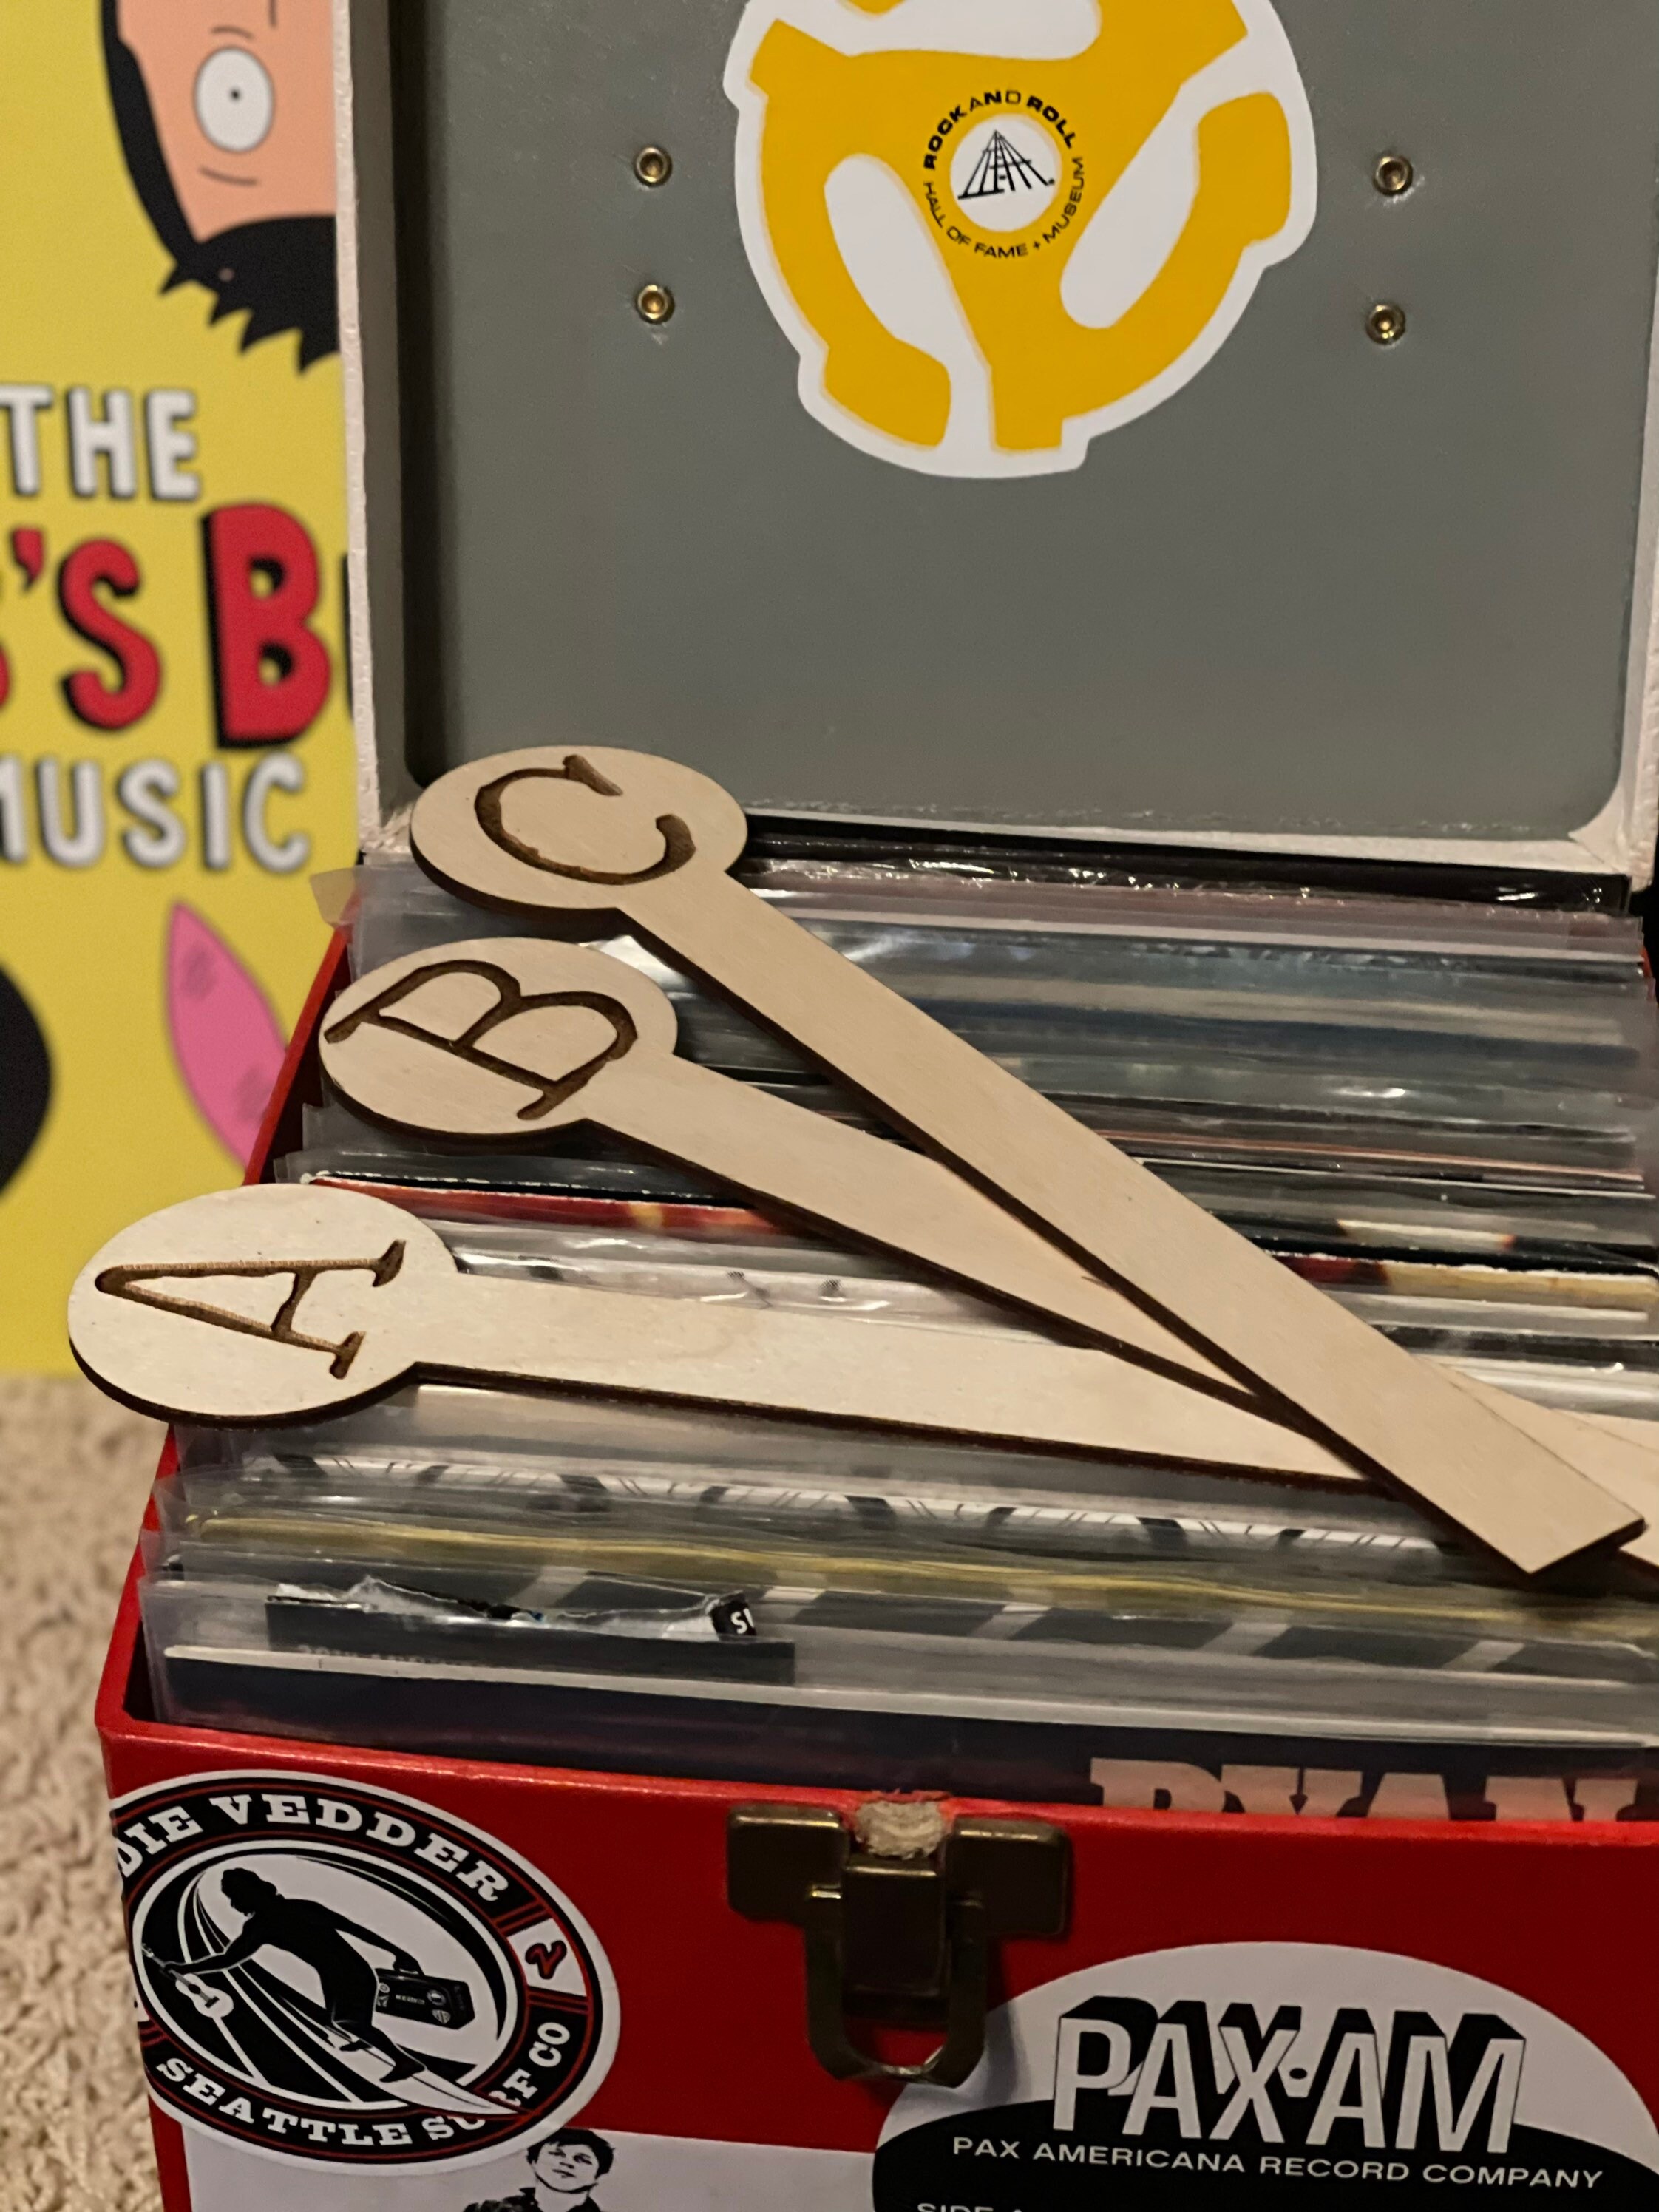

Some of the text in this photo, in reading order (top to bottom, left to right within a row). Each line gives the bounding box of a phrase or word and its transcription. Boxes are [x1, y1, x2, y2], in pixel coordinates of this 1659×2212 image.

[923, 90, 1076, 170] ROCK AND ROLL
[923, 181, 946, 228] HALL
[946, 225, 971, 245] OF
[974, 243, 1028, 258] FAME
[1042, 156, 1085, 243] MUSEUM
[0, 384, 200, 501] THE
[0, 503, 353, 750] 'S B
[475, 755, 696, 886] C
[324, 959, 638, 1121] B
[95, 1239, 406, 1380] A
[208, 1793, 509, 1902] VEDDER
[156, 2057, 413, 2146] SEATTLE
[528, 2021, 571, 2068] CO
[952, 2136, 1603, 2189] PAX AMERICANA RECORD COMPANY
